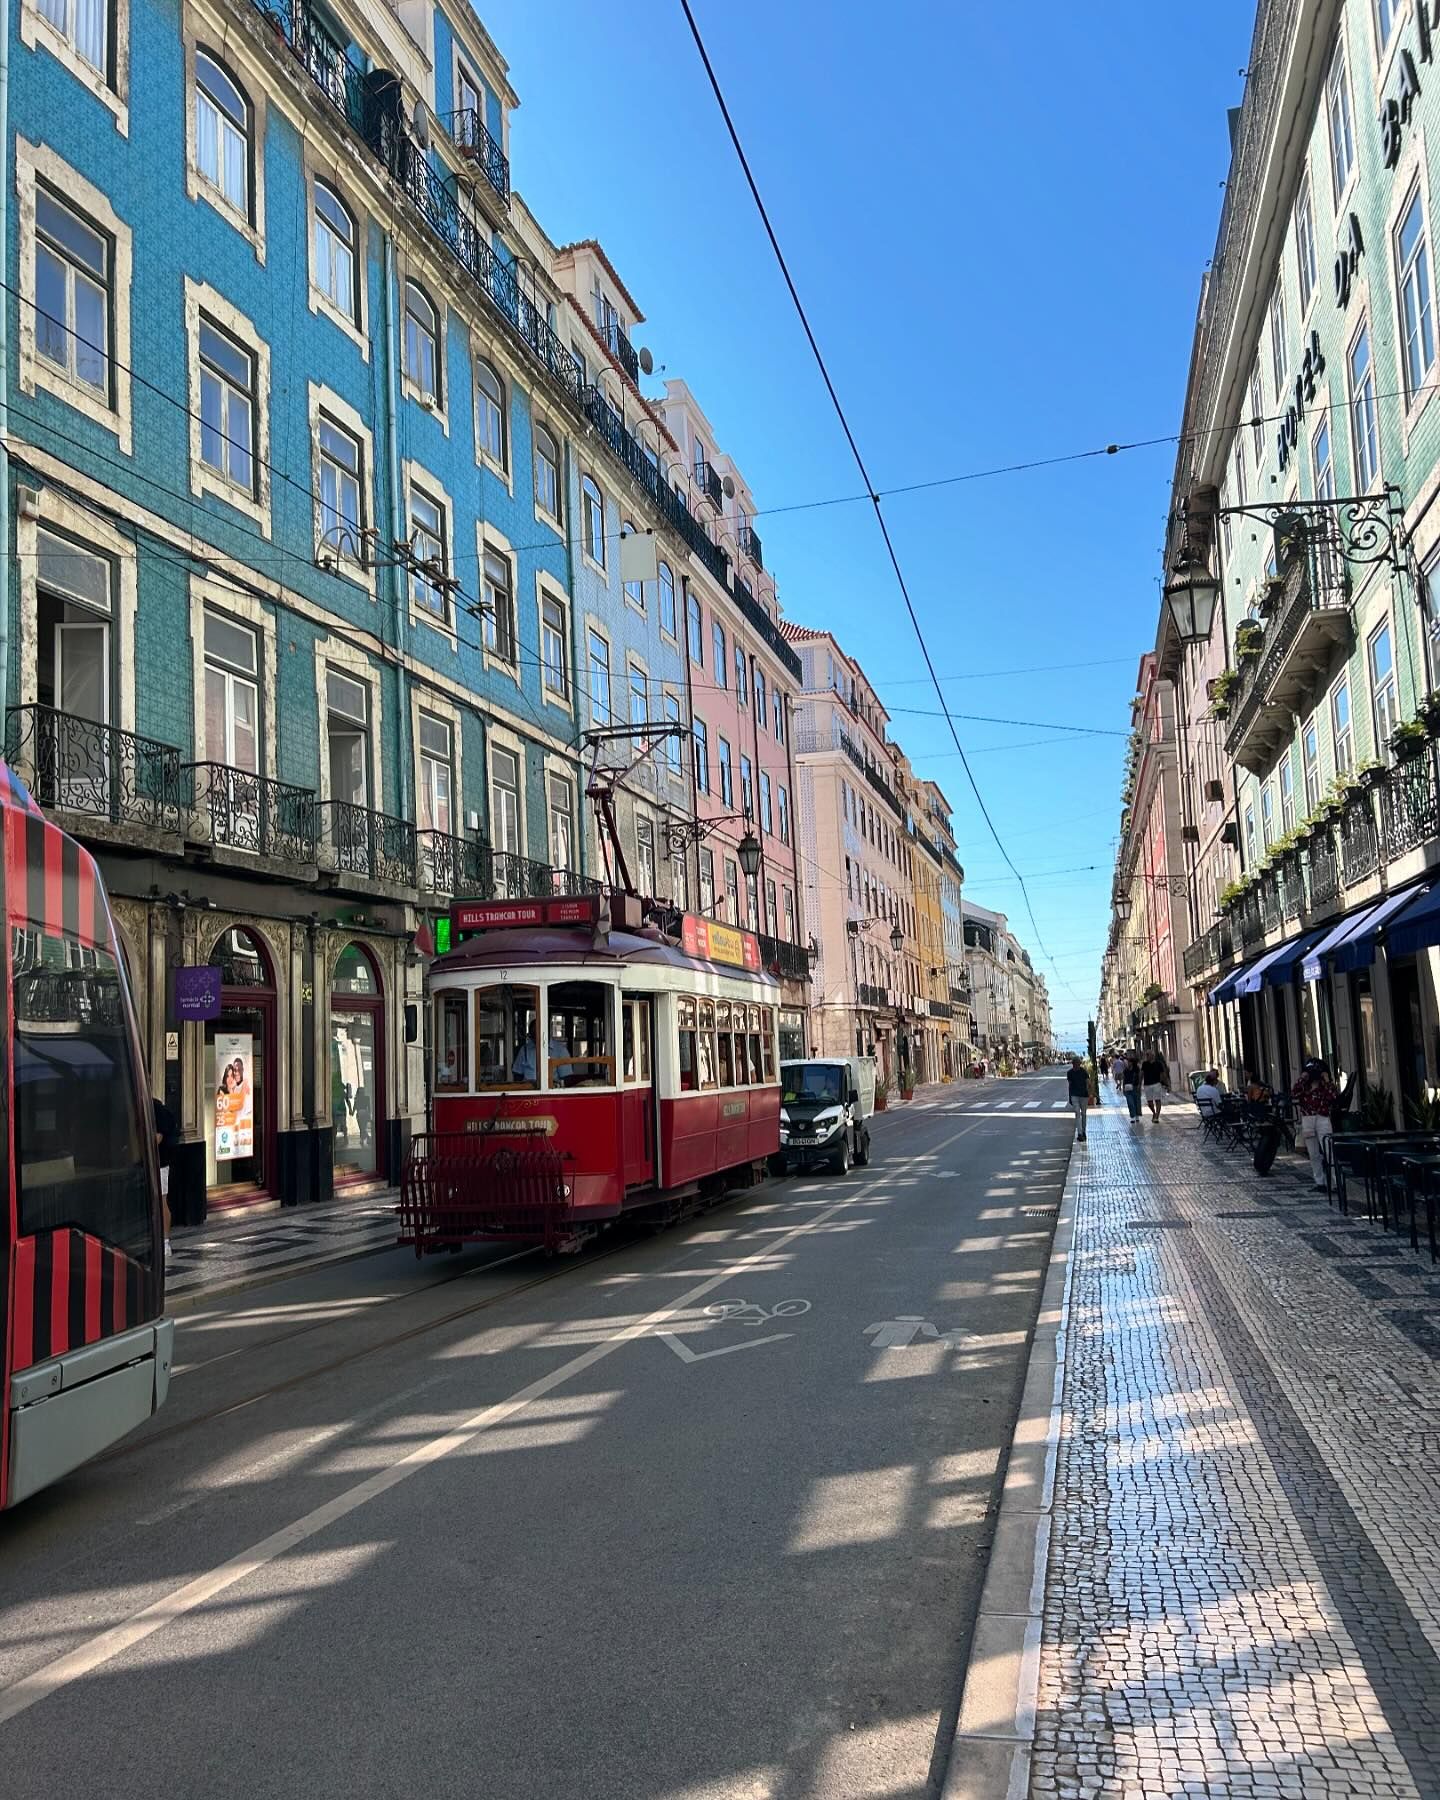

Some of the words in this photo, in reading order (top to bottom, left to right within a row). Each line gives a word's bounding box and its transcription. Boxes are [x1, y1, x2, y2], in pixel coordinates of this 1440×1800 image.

[1277, 329, 1325, 473] HOTEL
[1334, 211, 1364, 311] DA
[1380, 0, 1440, 171] BAI
[463, 911, 485, 923] HILLS
[517, 909, 536, 920] TOUR
[500, 970, 508, 980] 12
